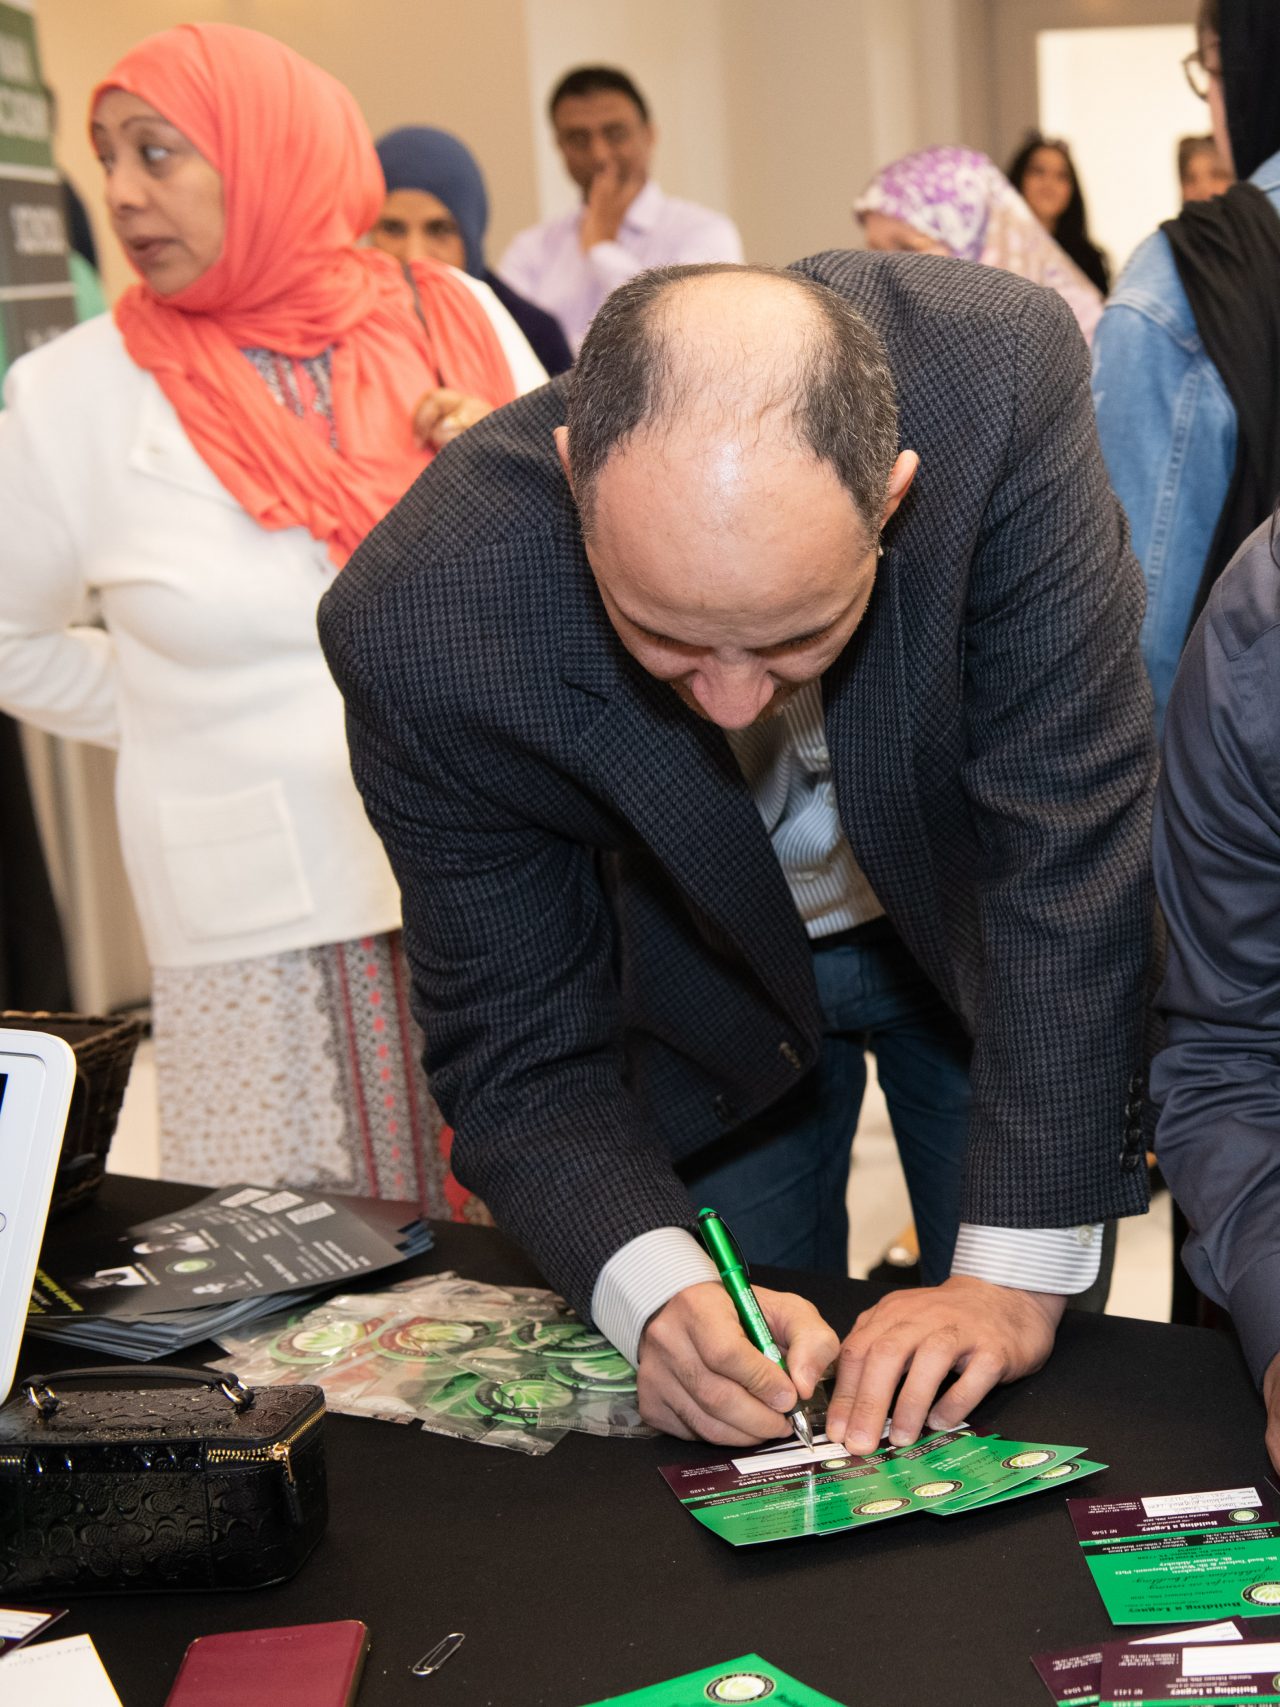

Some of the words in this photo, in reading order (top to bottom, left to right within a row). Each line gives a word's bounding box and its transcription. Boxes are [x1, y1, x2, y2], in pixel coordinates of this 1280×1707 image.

[1179, 1520, 1218, 1529] Building
[1185, 1602, 1241, 1610] Building
[1170, 1688, 1204, 1696] Legacy
[1214, 1686, 1258, 1695] Building
